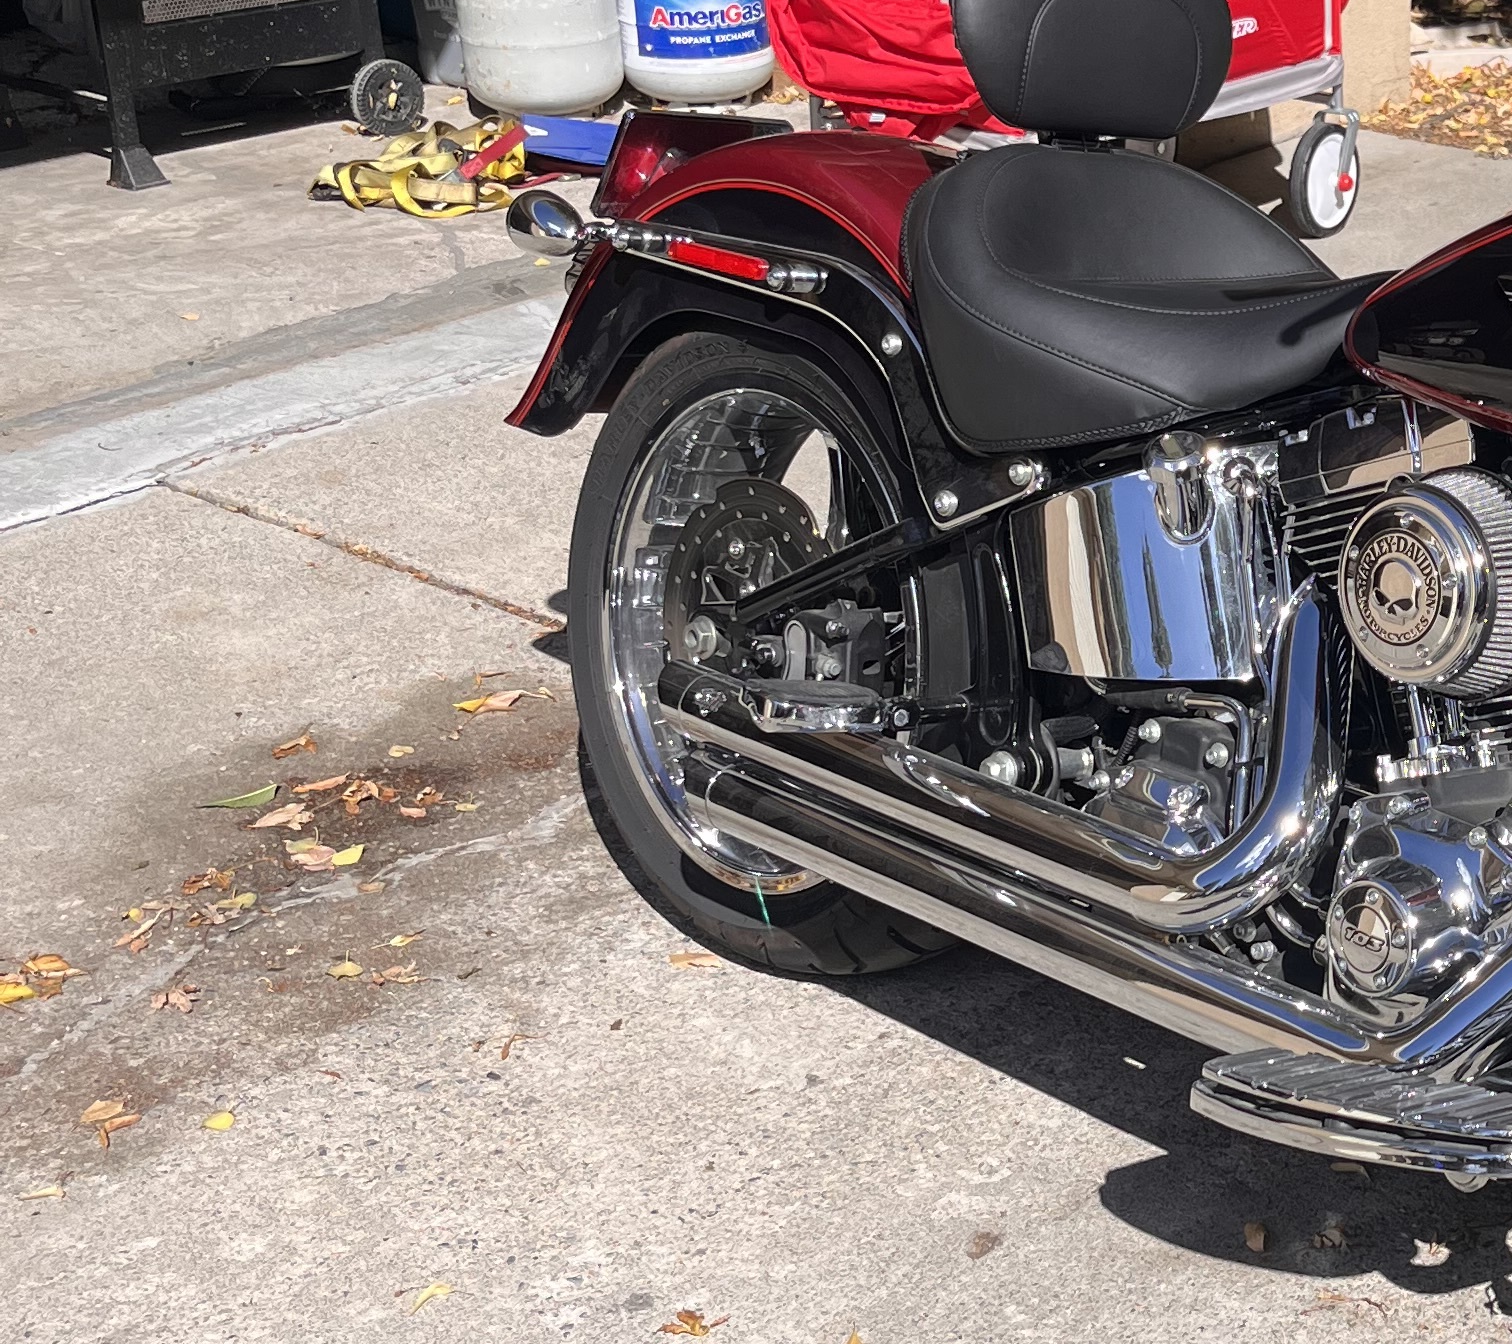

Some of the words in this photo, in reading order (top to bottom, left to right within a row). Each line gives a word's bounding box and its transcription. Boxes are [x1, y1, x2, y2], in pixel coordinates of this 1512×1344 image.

[649, 1, 763, 30] AmeriGas
[670, 34, 712, 45] PROPANE
[714, 29, 756, 44] EXCHANGE
[1357, 534, 1437, 610] HARLEY-DAVIDSON
[1358, 592, 1430, 642] MOTORCYCLES
[1345, 926, 1386, 952] 103
